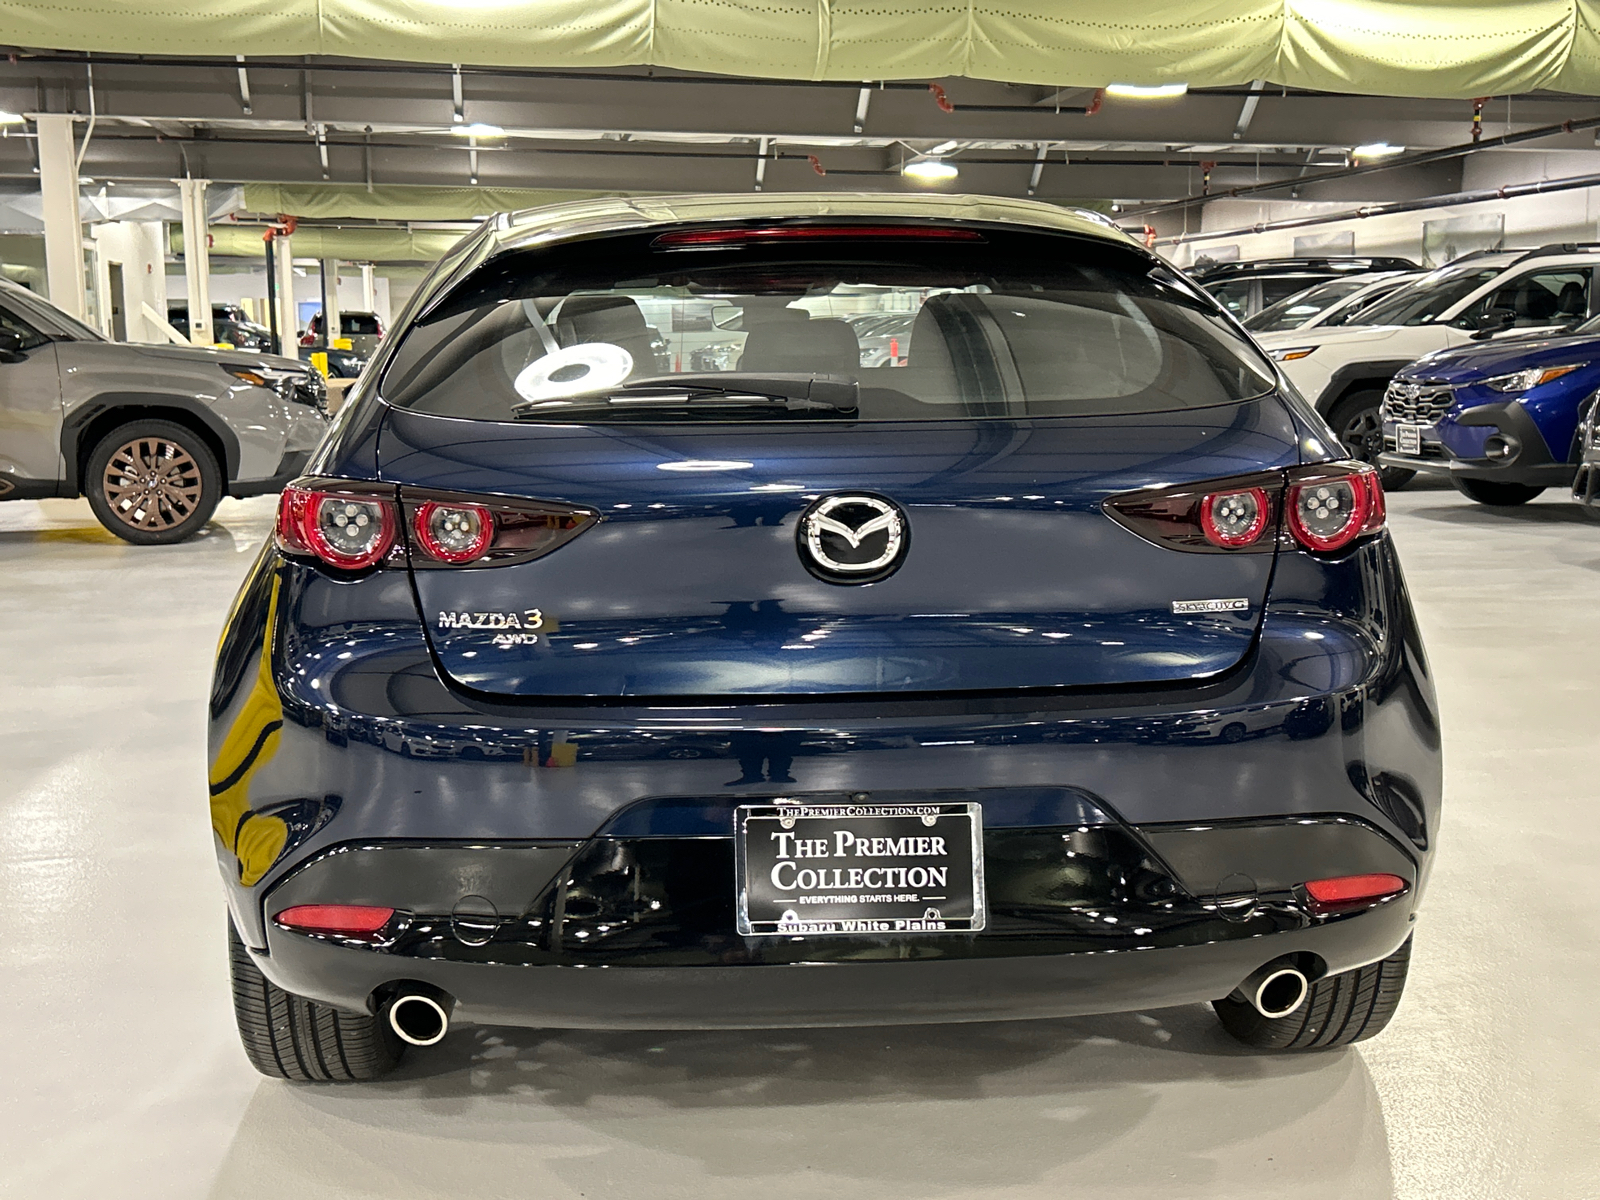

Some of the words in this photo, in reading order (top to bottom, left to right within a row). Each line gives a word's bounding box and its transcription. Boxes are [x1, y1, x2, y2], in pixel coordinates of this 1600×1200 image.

[491, 633, 538, 645] AWD
[770, 831, 829, 859] THE
[833, 830, 948, 858] PREMIER
[770, 861, 949, 891] COLLECTION
[799, 895, 858, 905] EVERYTHING
[859, 894, 892, 904] STARTS
[894, 893, 920, 903] HERE.
[777, 921, 836, 933] Subaru
[842, 920, 890, 932] White
[895, 919, 947, 931] Plains
